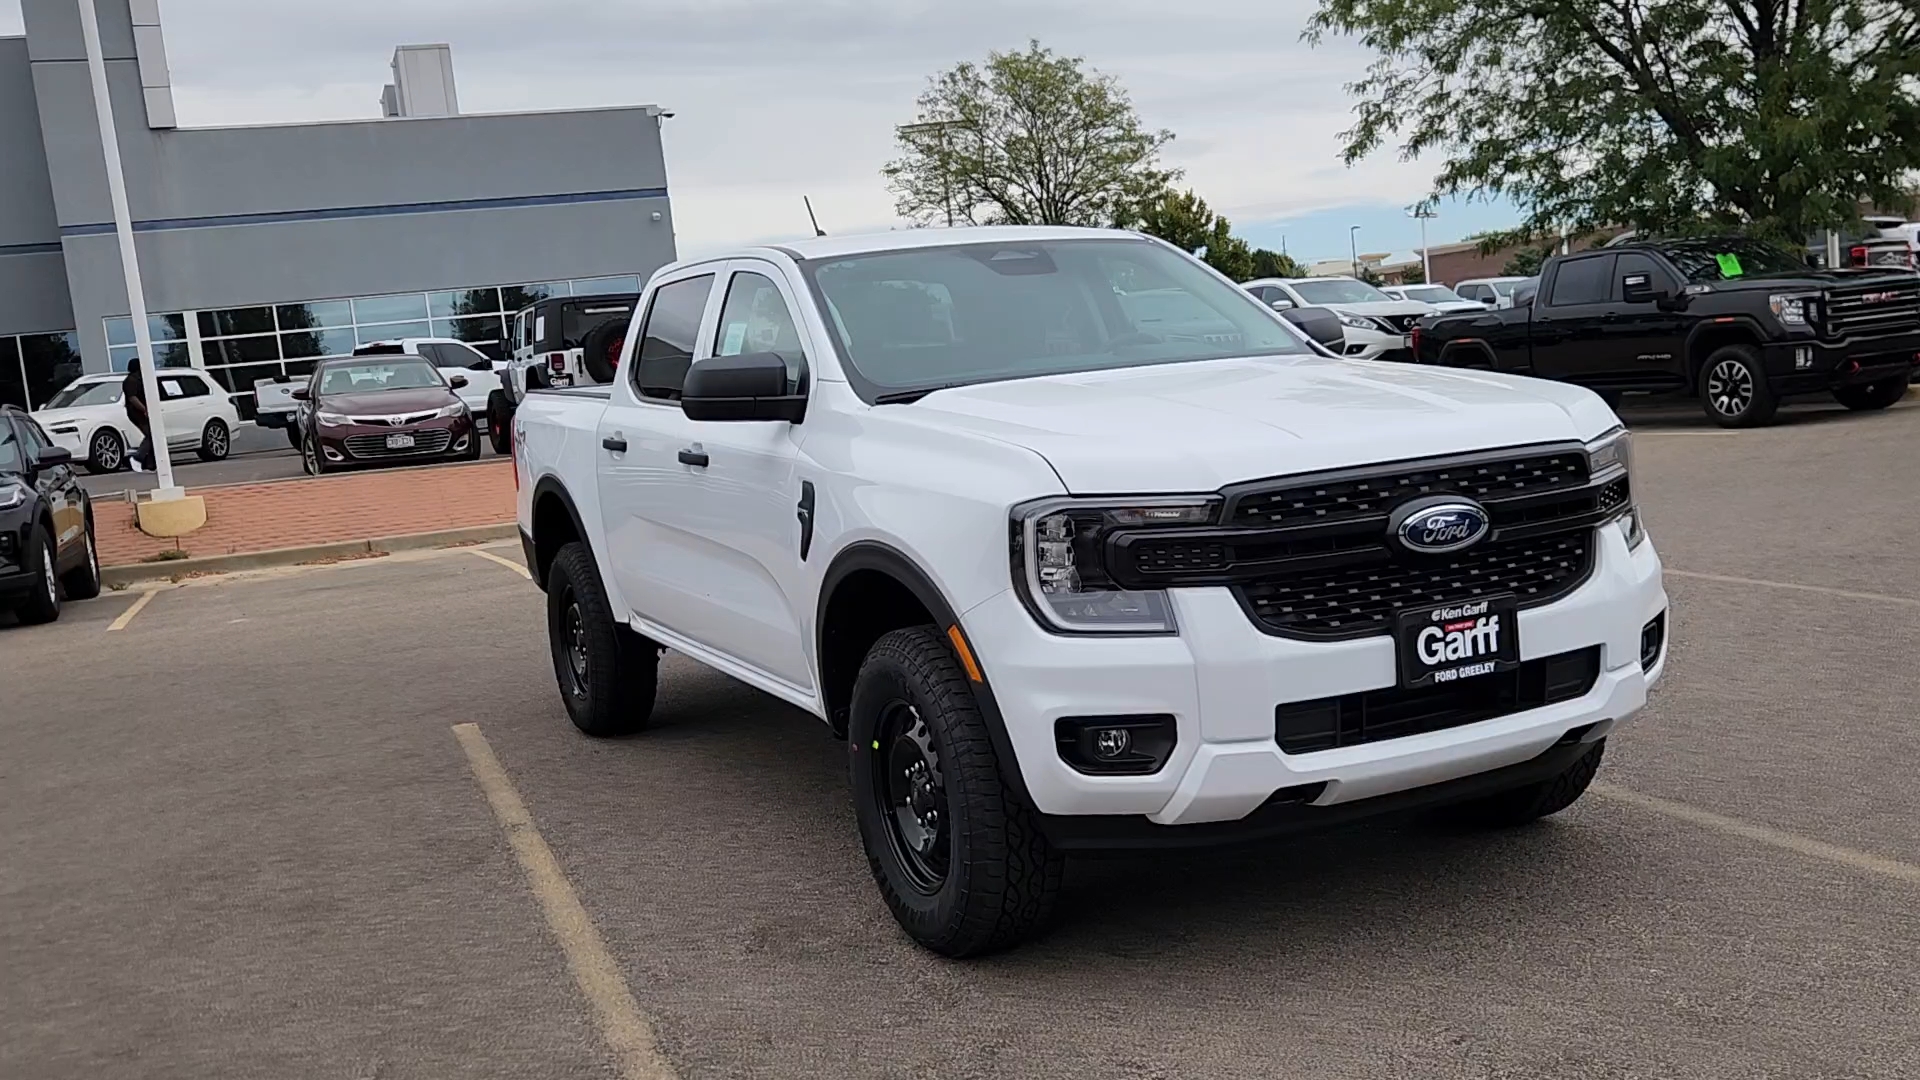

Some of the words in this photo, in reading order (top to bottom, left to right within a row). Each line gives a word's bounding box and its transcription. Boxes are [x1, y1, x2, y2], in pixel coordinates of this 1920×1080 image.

[1423, 514, 1470, 543] Ford
[1441, 608, 1461, 620] Ken
[1462, 601, 1488, 617] Garff
[1417, 615, 1499, 665] Garff
[1435, 670, 1457, 683] FORD
[1459, 662, 1495, 678] GREELEY
